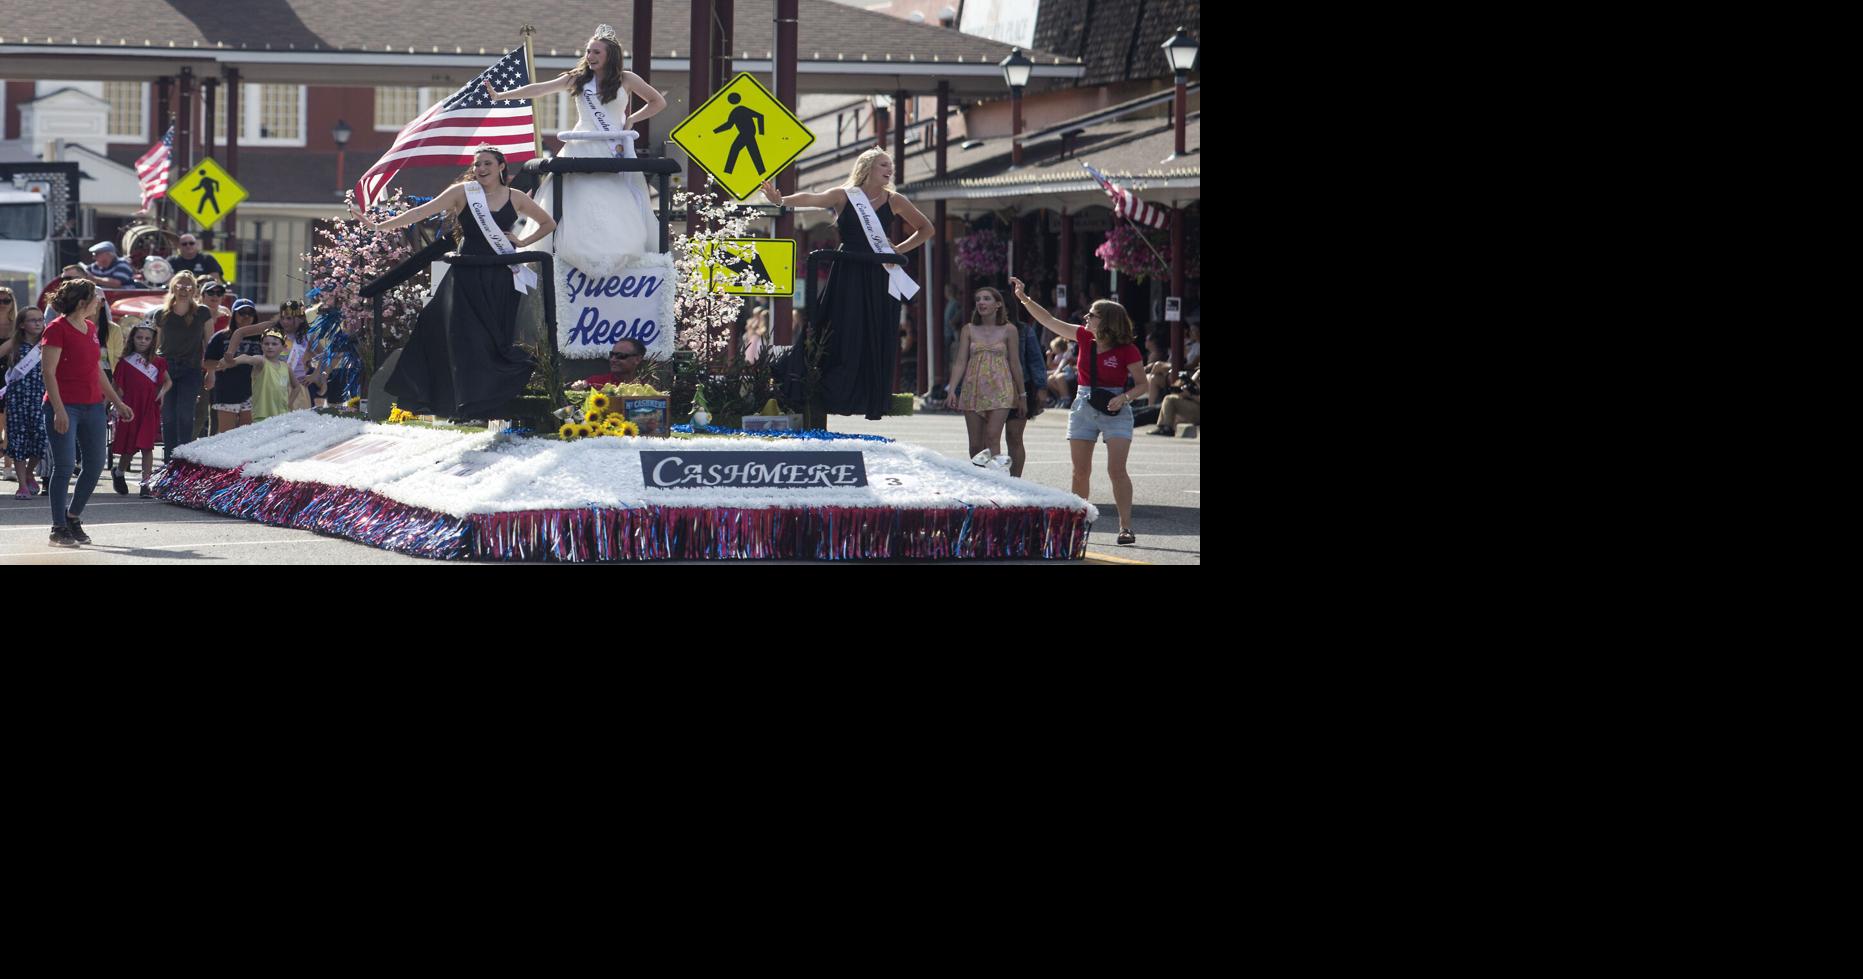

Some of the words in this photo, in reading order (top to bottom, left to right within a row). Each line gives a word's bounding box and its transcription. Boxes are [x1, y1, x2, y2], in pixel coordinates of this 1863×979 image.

[566, 267, 664, 303] Queen
[565, 306, 660, 346] Reese
[652, 456, 858, 488] CASHMERE
[885, 477, 903, 486] 3
